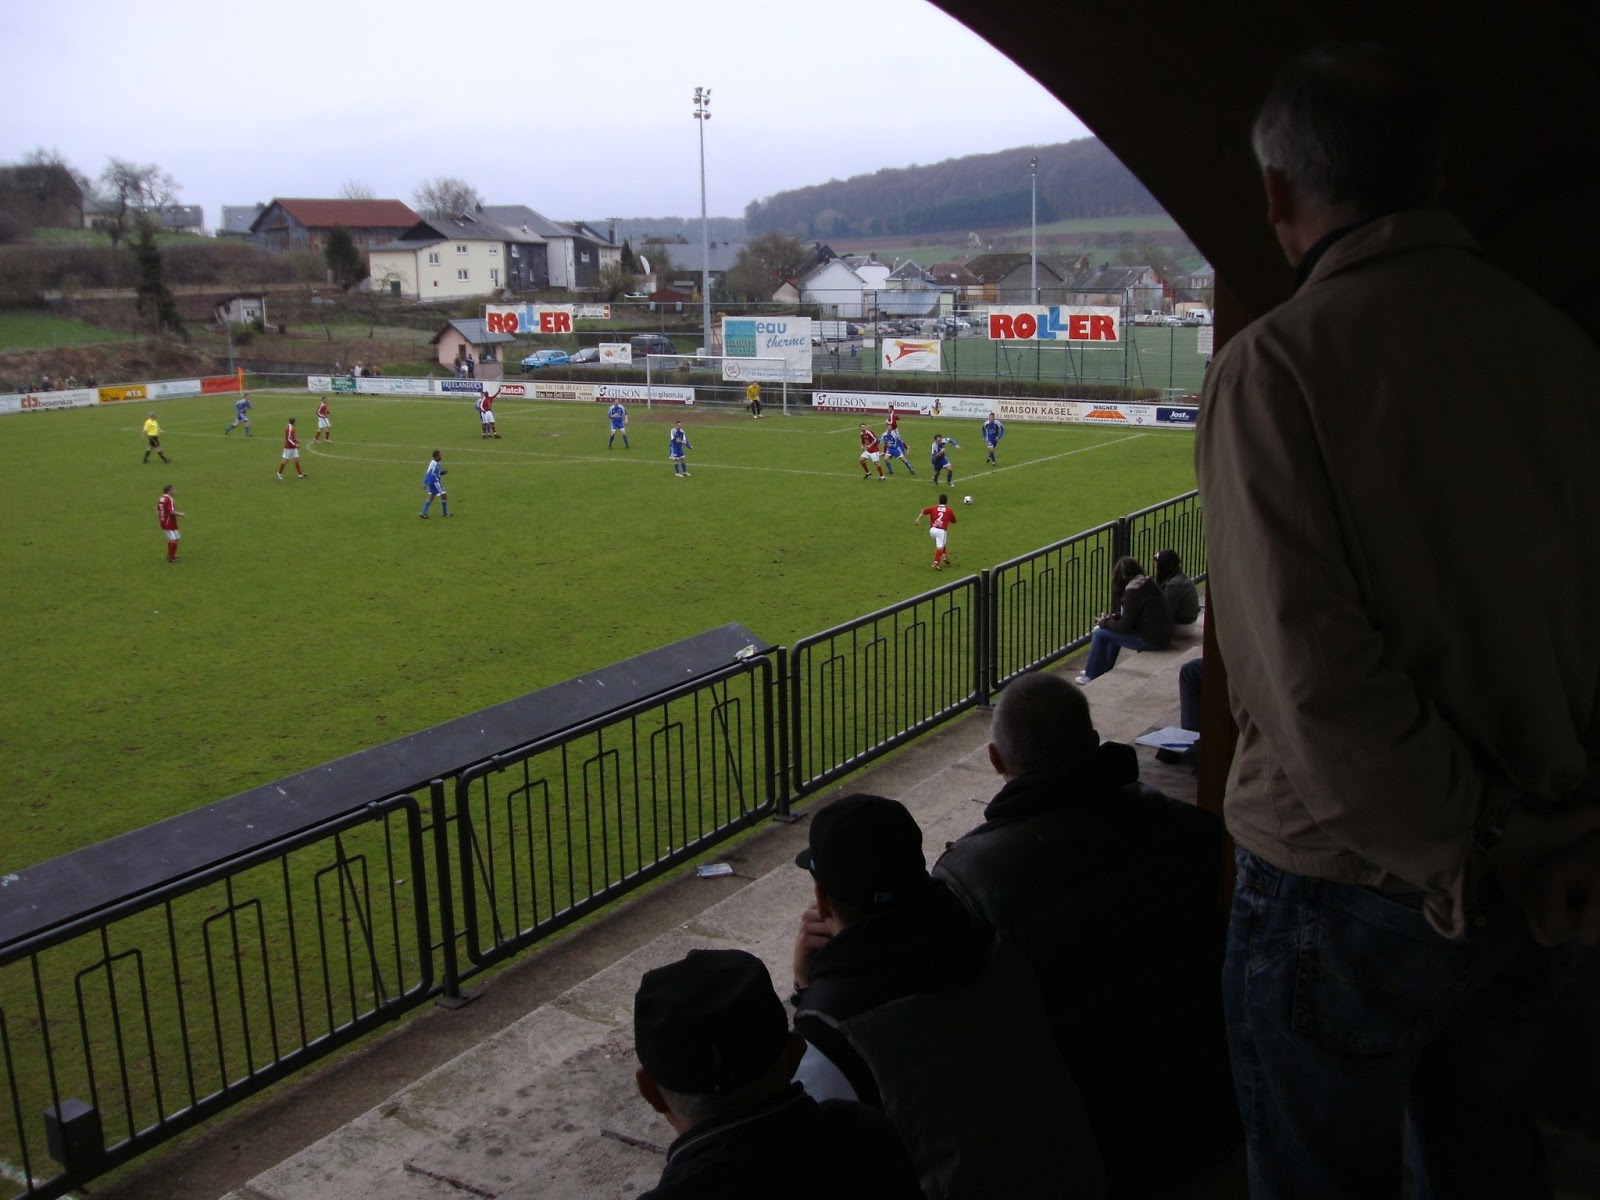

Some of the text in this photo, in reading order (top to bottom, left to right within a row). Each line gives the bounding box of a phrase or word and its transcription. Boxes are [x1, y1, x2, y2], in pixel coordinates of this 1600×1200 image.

[488, 305, 571, 333] ROLLER
[990, 306, 1117, 341] ROLLER
[766, 335, 805, 348] therme
[500, 385, 524, 395] Match
[608, 388, 641, 398] GILSON
[827, 397, 867, 407] GILSON
[1000, 405, 1073, 416] MAISON KASEL
[1169, 410, 1186, 418] Jost
[937, 512, 944, 521] 2
